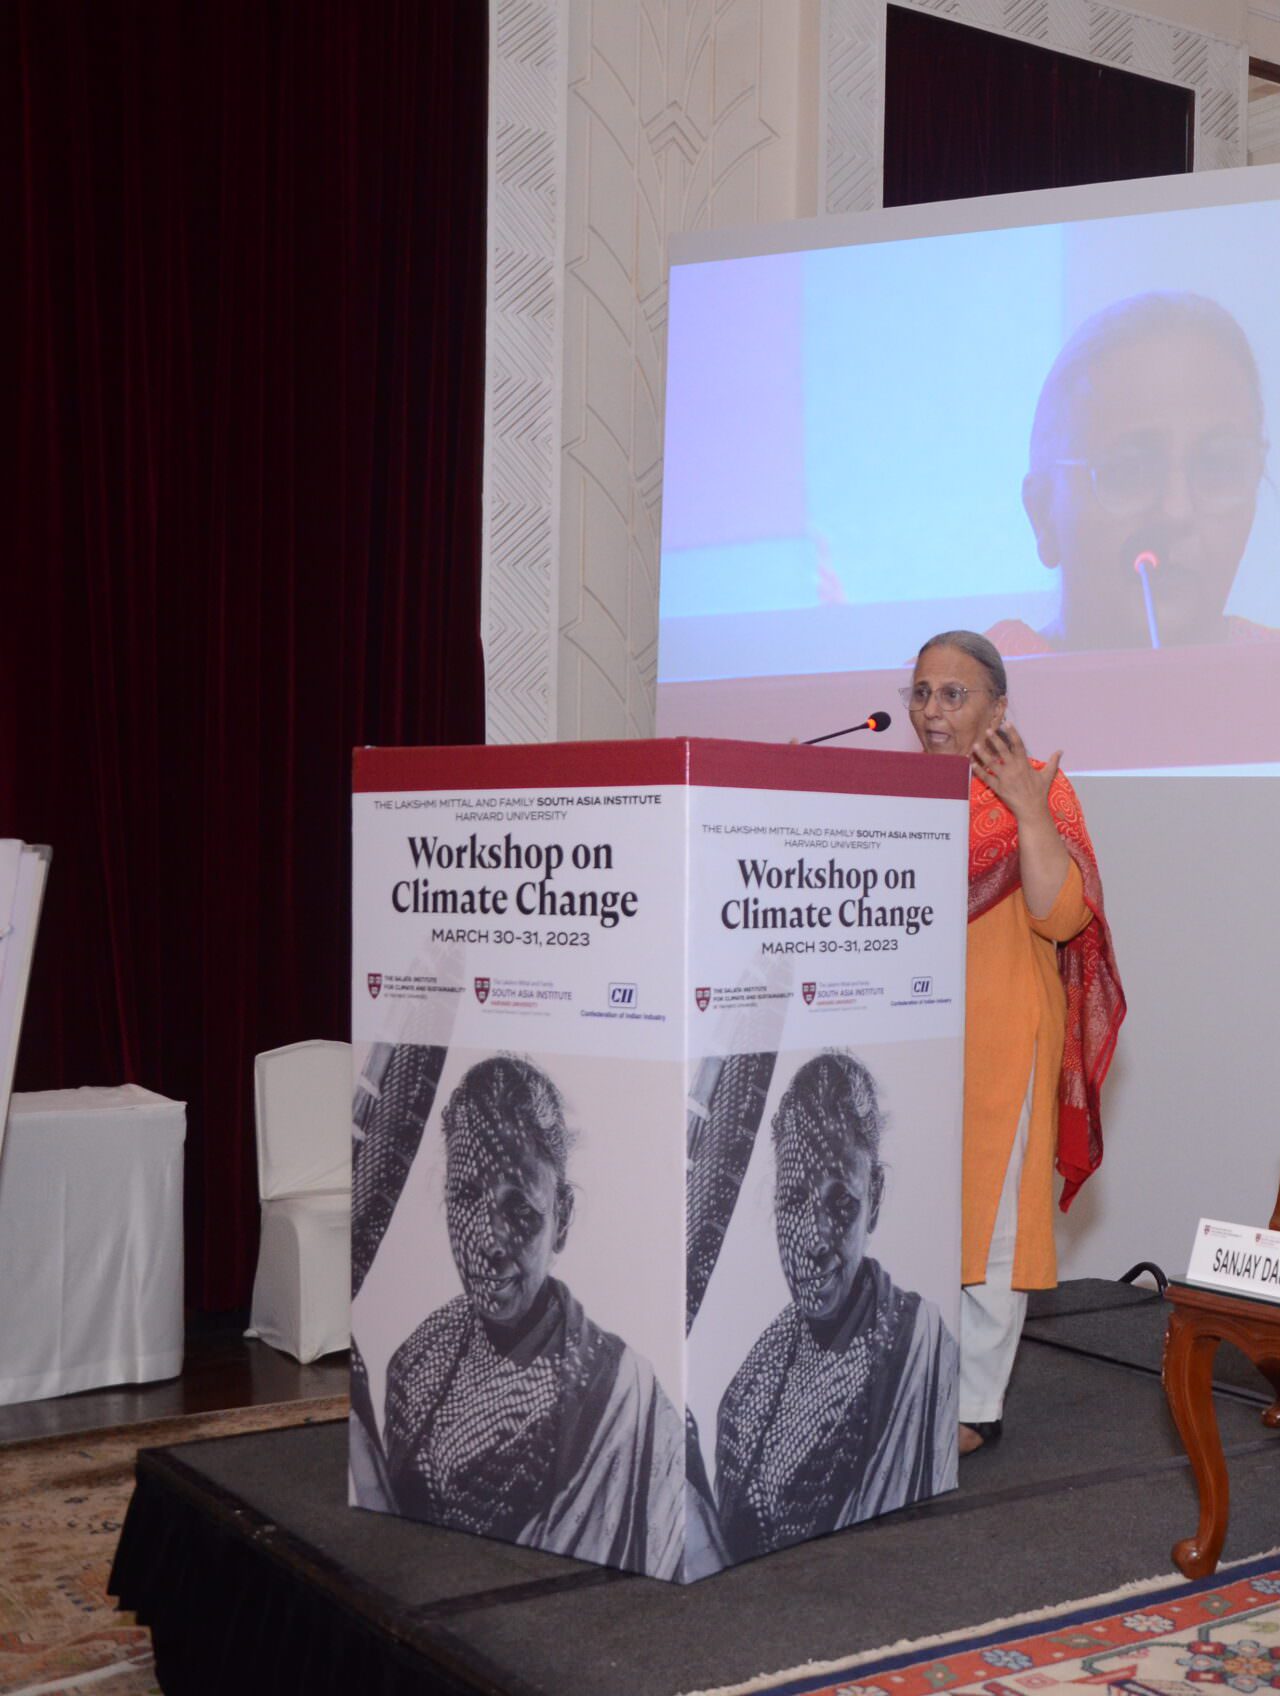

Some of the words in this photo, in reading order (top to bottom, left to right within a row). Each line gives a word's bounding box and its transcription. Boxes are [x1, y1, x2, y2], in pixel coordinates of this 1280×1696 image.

[374, 800, 392, 810] THE
[394, 800, 436, 809] LAKSHMI
[439, 799, 474, 808] MITTAL
[476, 798, 498, 808] AND
[499, 798, 534, 807] FAMILY
[537, 797, 574, 806] SOUTH
[576, 796, 600, 805] ASIA
[603, 795, 661, 805] INSTITUTE
[456, 811, 503, 822] HARVARD
[506, 810, 567, 820] UNIVERSITY
[702, 824, 722, 833] THE
[725, 826, 767, 834] LAKSHMI
[769, 827, 800, 835] MITTAL
[803, 828, 822, 836] AND
[824, 829, 855, 837] FAMILY
[857, 830, 886, 838] SOUTH
[888, 831, 907, 839] ASIA
[909, 832, 950, 840] INSTITUTE
[785, 840, 829, 848] HARVARD
[831, 841, 881, 849] UNIVERSITY
[408, 833, 564, 880] Workshop
[572, 844, 614, 869] on
[738, 858, 878, 897] Workshop
[884, 868, 915, 889] on
[392, 879, 508, 914] Climate
[516, 879, 638, 928] Change
[721, 897, 832, 929] Climate
[839, 897, 933, 935] Change
[432, 929, 488, 943] MARCH
[493, 930, 543, 947] 30-31,
[546, 932, 590, 946] 2023
[762, 941, 815, 954] MARCH
[819, 941, 860, 954] 30-31,
[864, 939, 898, 951] 2023
[913, 980, 930, 993] CII
[492, 989, 515, 997] SOUTH
[518, 989, 533, 998] ASIA
[536, 991, 572, 1000] INSTITUTE
[611, 988, 633, 1003] CII
[1213, 1248, 1262, 1280] SANJAY
